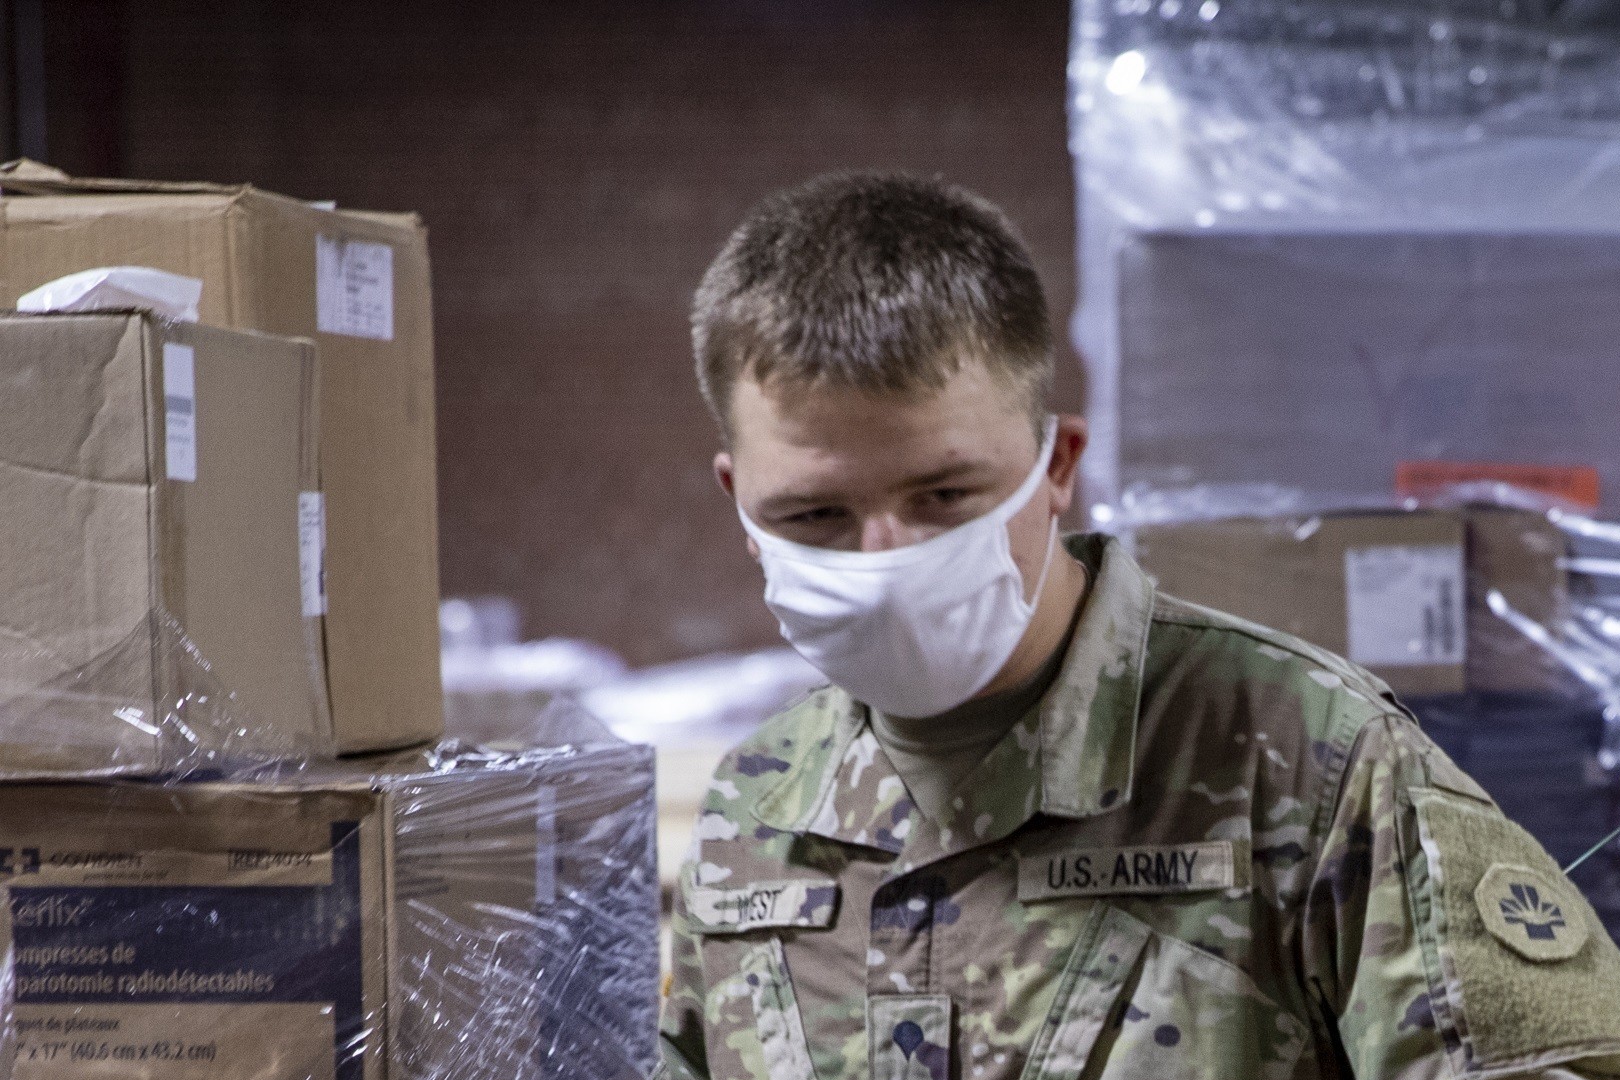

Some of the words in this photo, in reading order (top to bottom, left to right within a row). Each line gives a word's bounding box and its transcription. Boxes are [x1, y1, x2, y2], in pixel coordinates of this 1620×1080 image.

[1047, 855, 1098, 891] U.S.
[1110, 849, 1200, 887] ARMY
[111, 942, 136, 965] de
[111, 1045, 136, 1061] cm
